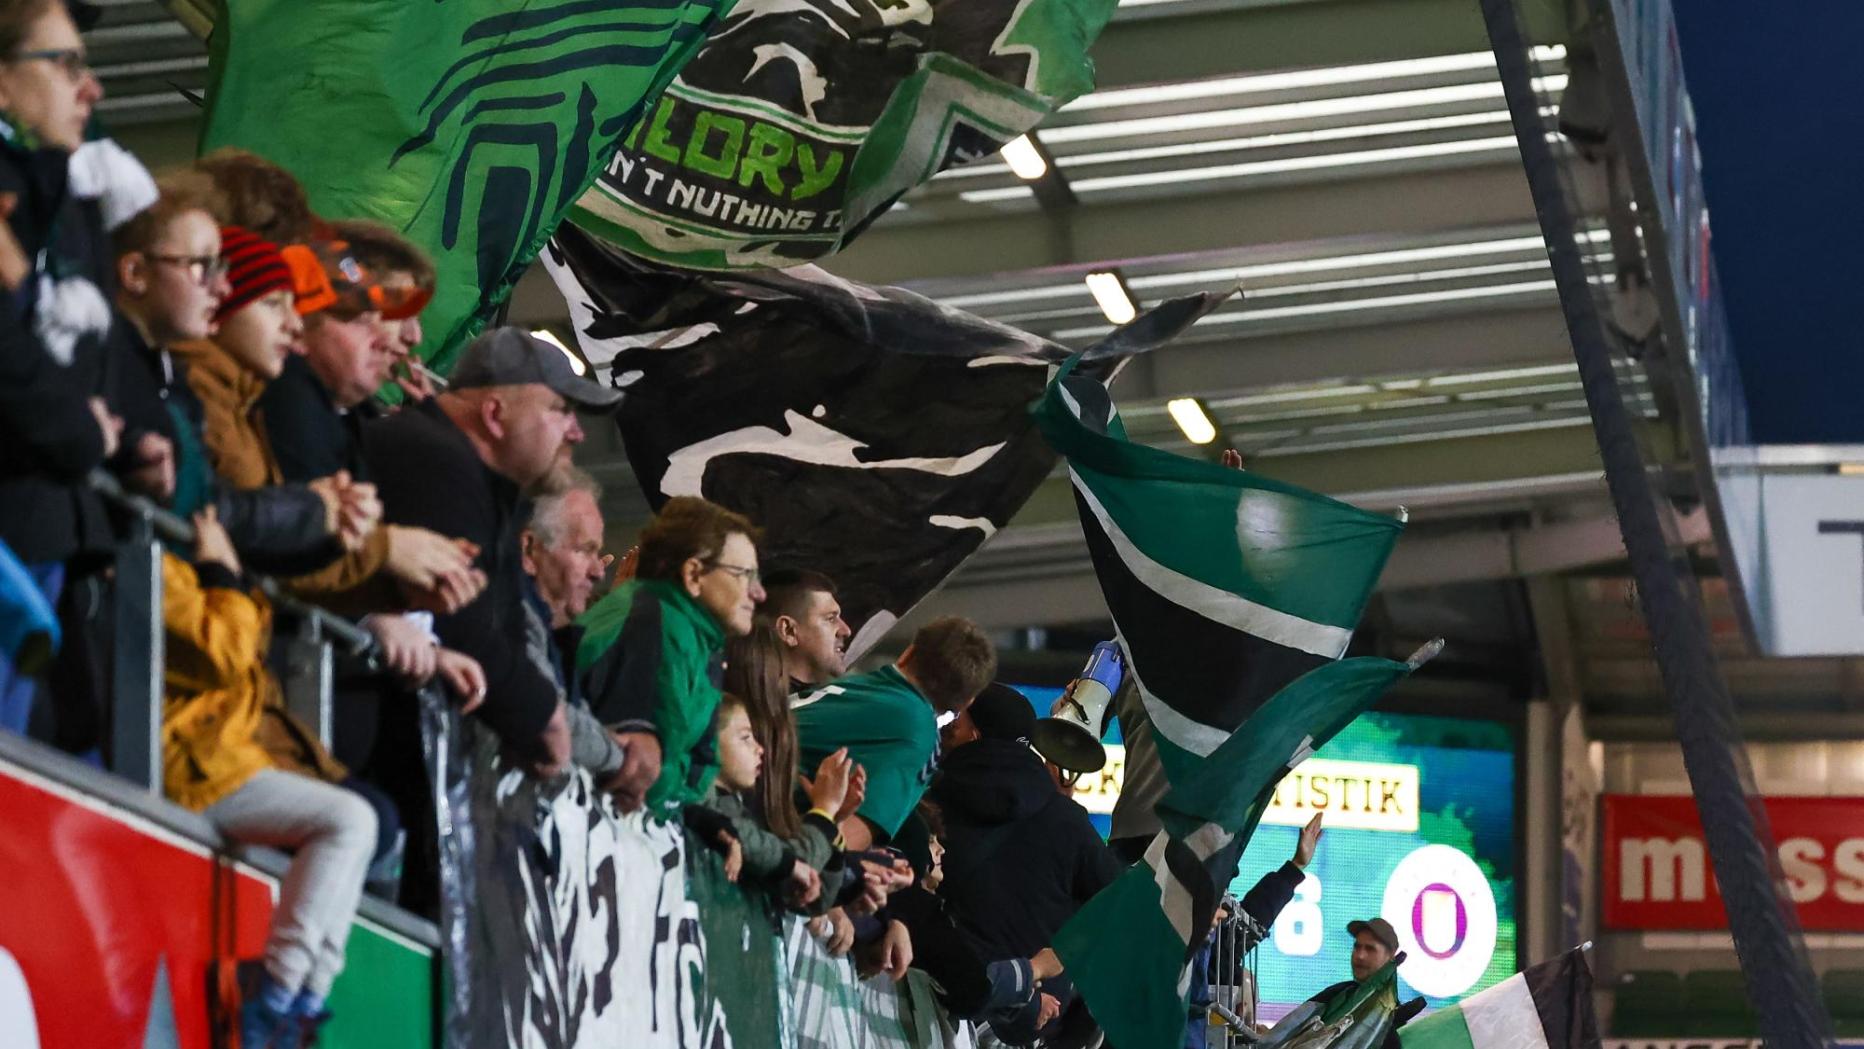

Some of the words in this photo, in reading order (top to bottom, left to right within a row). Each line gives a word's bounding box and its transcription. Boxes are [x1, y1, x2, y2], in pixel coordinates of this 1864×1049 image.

[624, 97, 843, 199] LORY
[604, 150, 664, 196] N'T
[666, 179, 817, 230] NUTHING
[1620, 837, 1864, 902] mss
